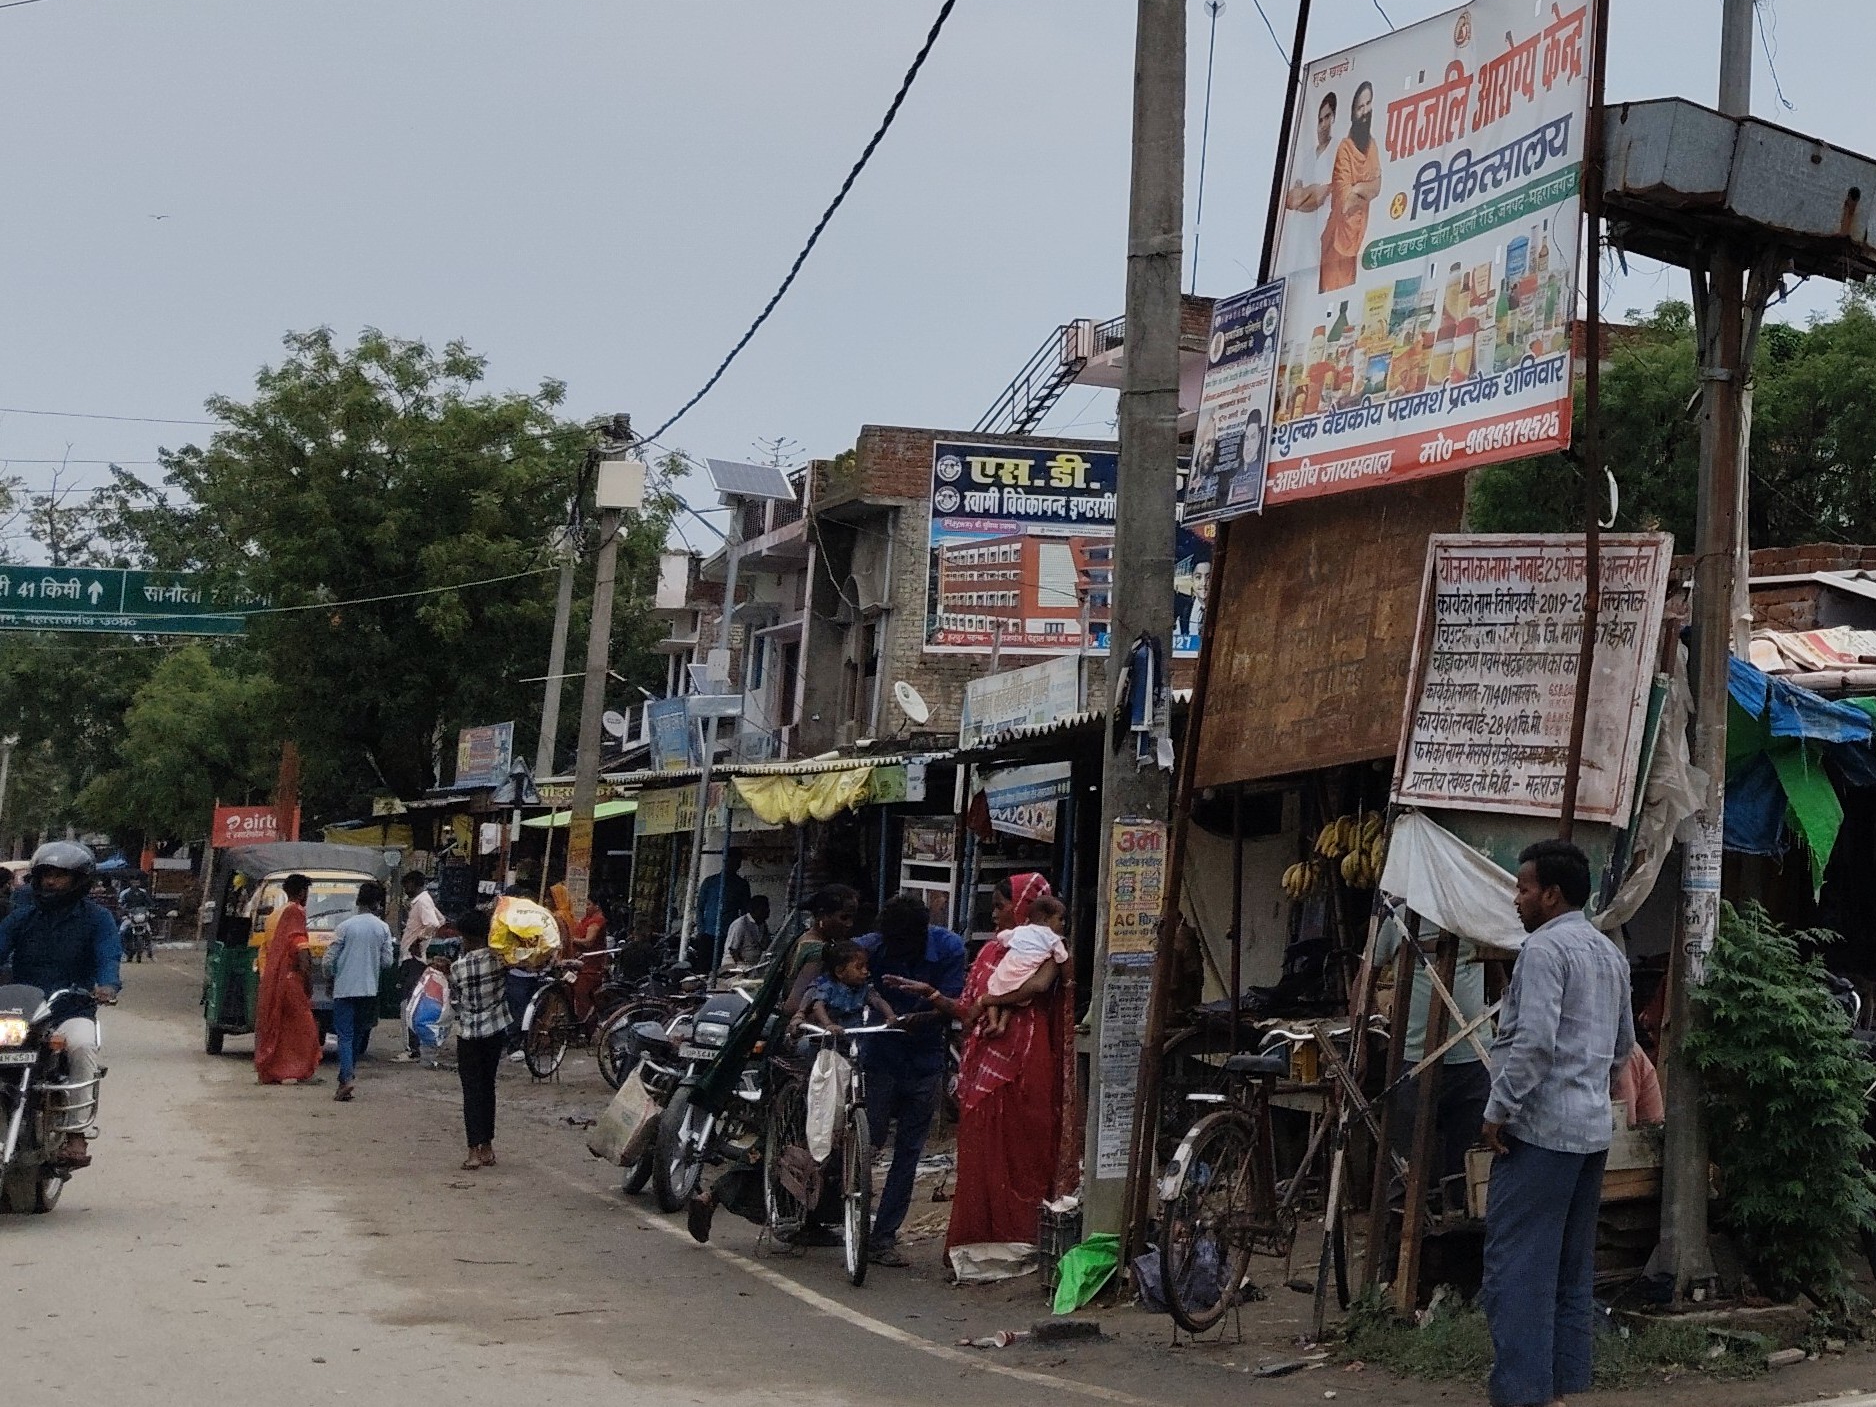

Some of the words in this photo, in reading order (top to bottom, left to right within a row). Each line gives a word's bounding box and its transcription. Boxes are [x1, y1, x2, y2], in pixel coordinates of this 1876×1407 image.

[1472, 30, 1542, 133] आरोग्य
[1390, 192, 1407, 220] &
[1409, 112, 1573, 221] चिकित्सालय
[1321, 394, 1385, 435] वैद्यकीय
[1387, 377, 1449, 422] परामर्श
[1447, 371, 1501, 415] प्रत्येक
[1503, 353, 1565, 396] शनिवार
[1319, 449, 1396, 483] जायसवाल
[963, 486, 1000, 515] स्वामी
[1002, 487, 1066, 518] विवेकानन्द
[17, 581, 35, 599] 41
[40, 576, 82, 600] किमी
[1114, 913, 1135, 927] AC
